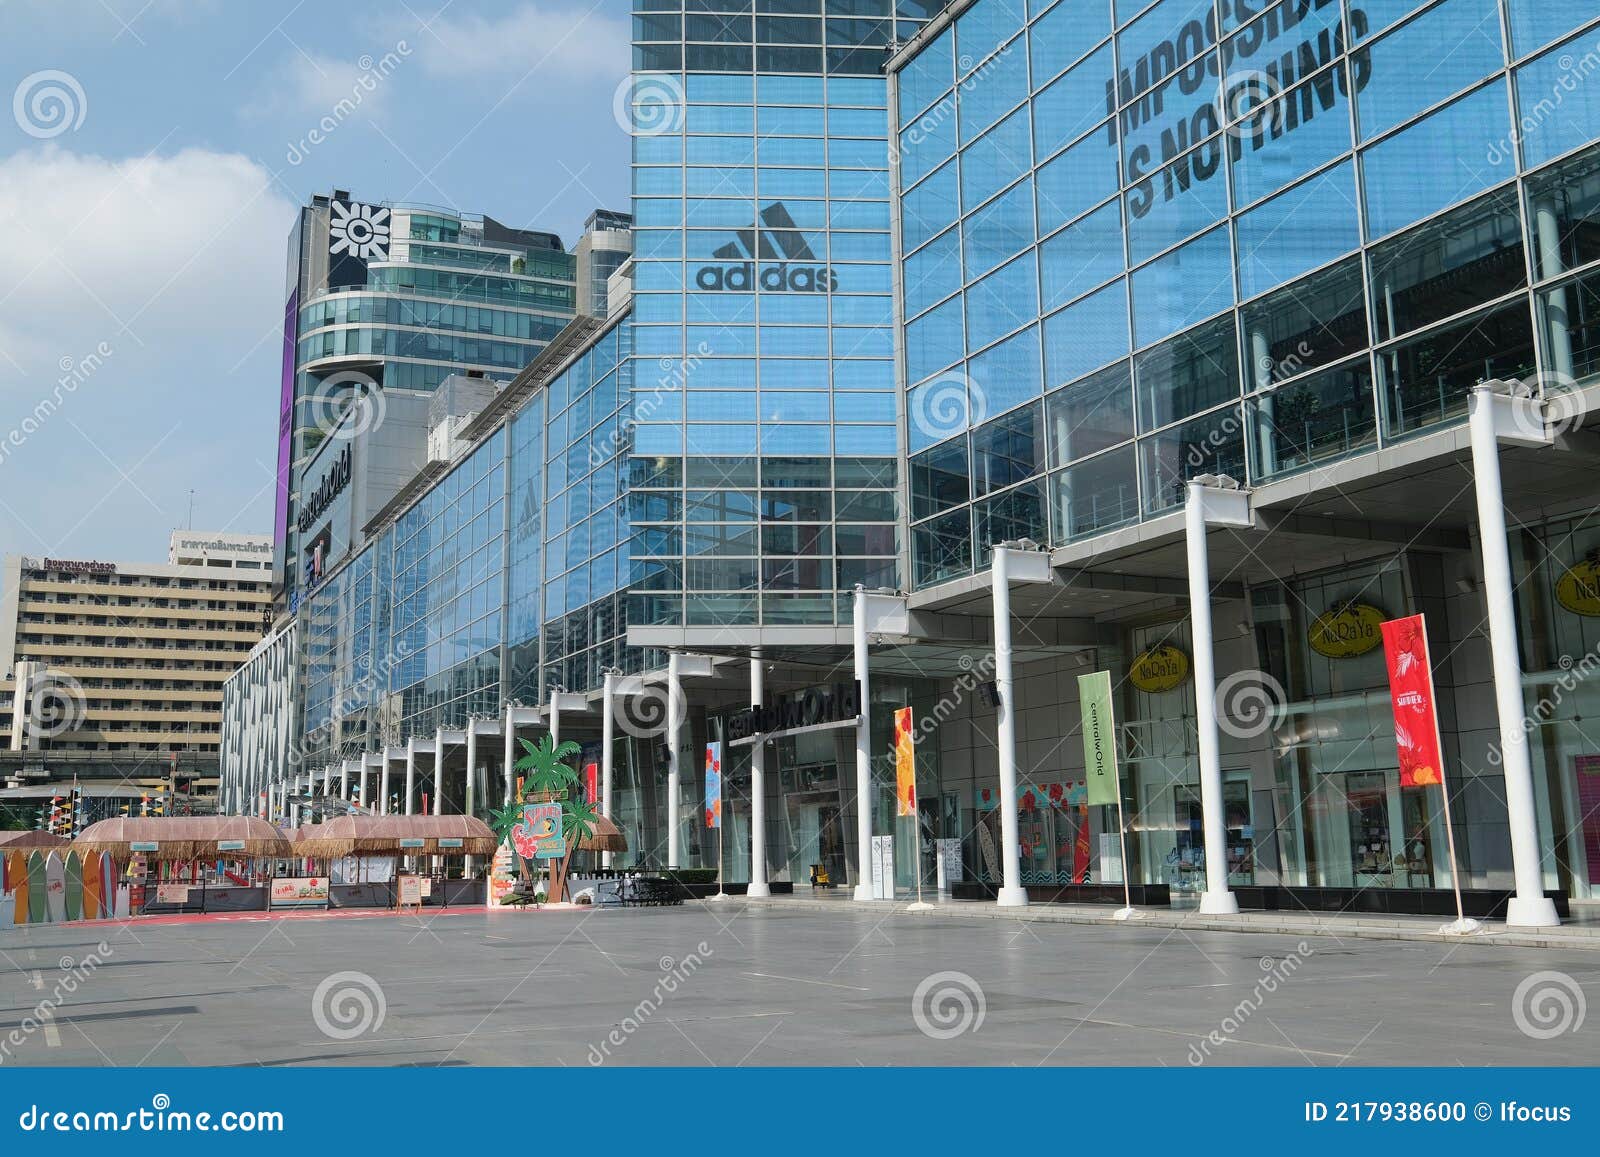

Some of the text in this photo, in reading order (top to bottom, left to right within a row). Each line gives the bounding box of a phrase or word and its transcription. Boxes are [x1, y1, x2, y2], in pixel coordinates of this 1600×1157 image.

[1160, 9, 1372, 202] NOTHING
[696, 262, 838, 292] adidas
[1322, 619, 1374, 645] NaRaYa
[1139, 658, 1178, 681] NaRaYa
[1090, 702, 1104, 776] centralwOrld
